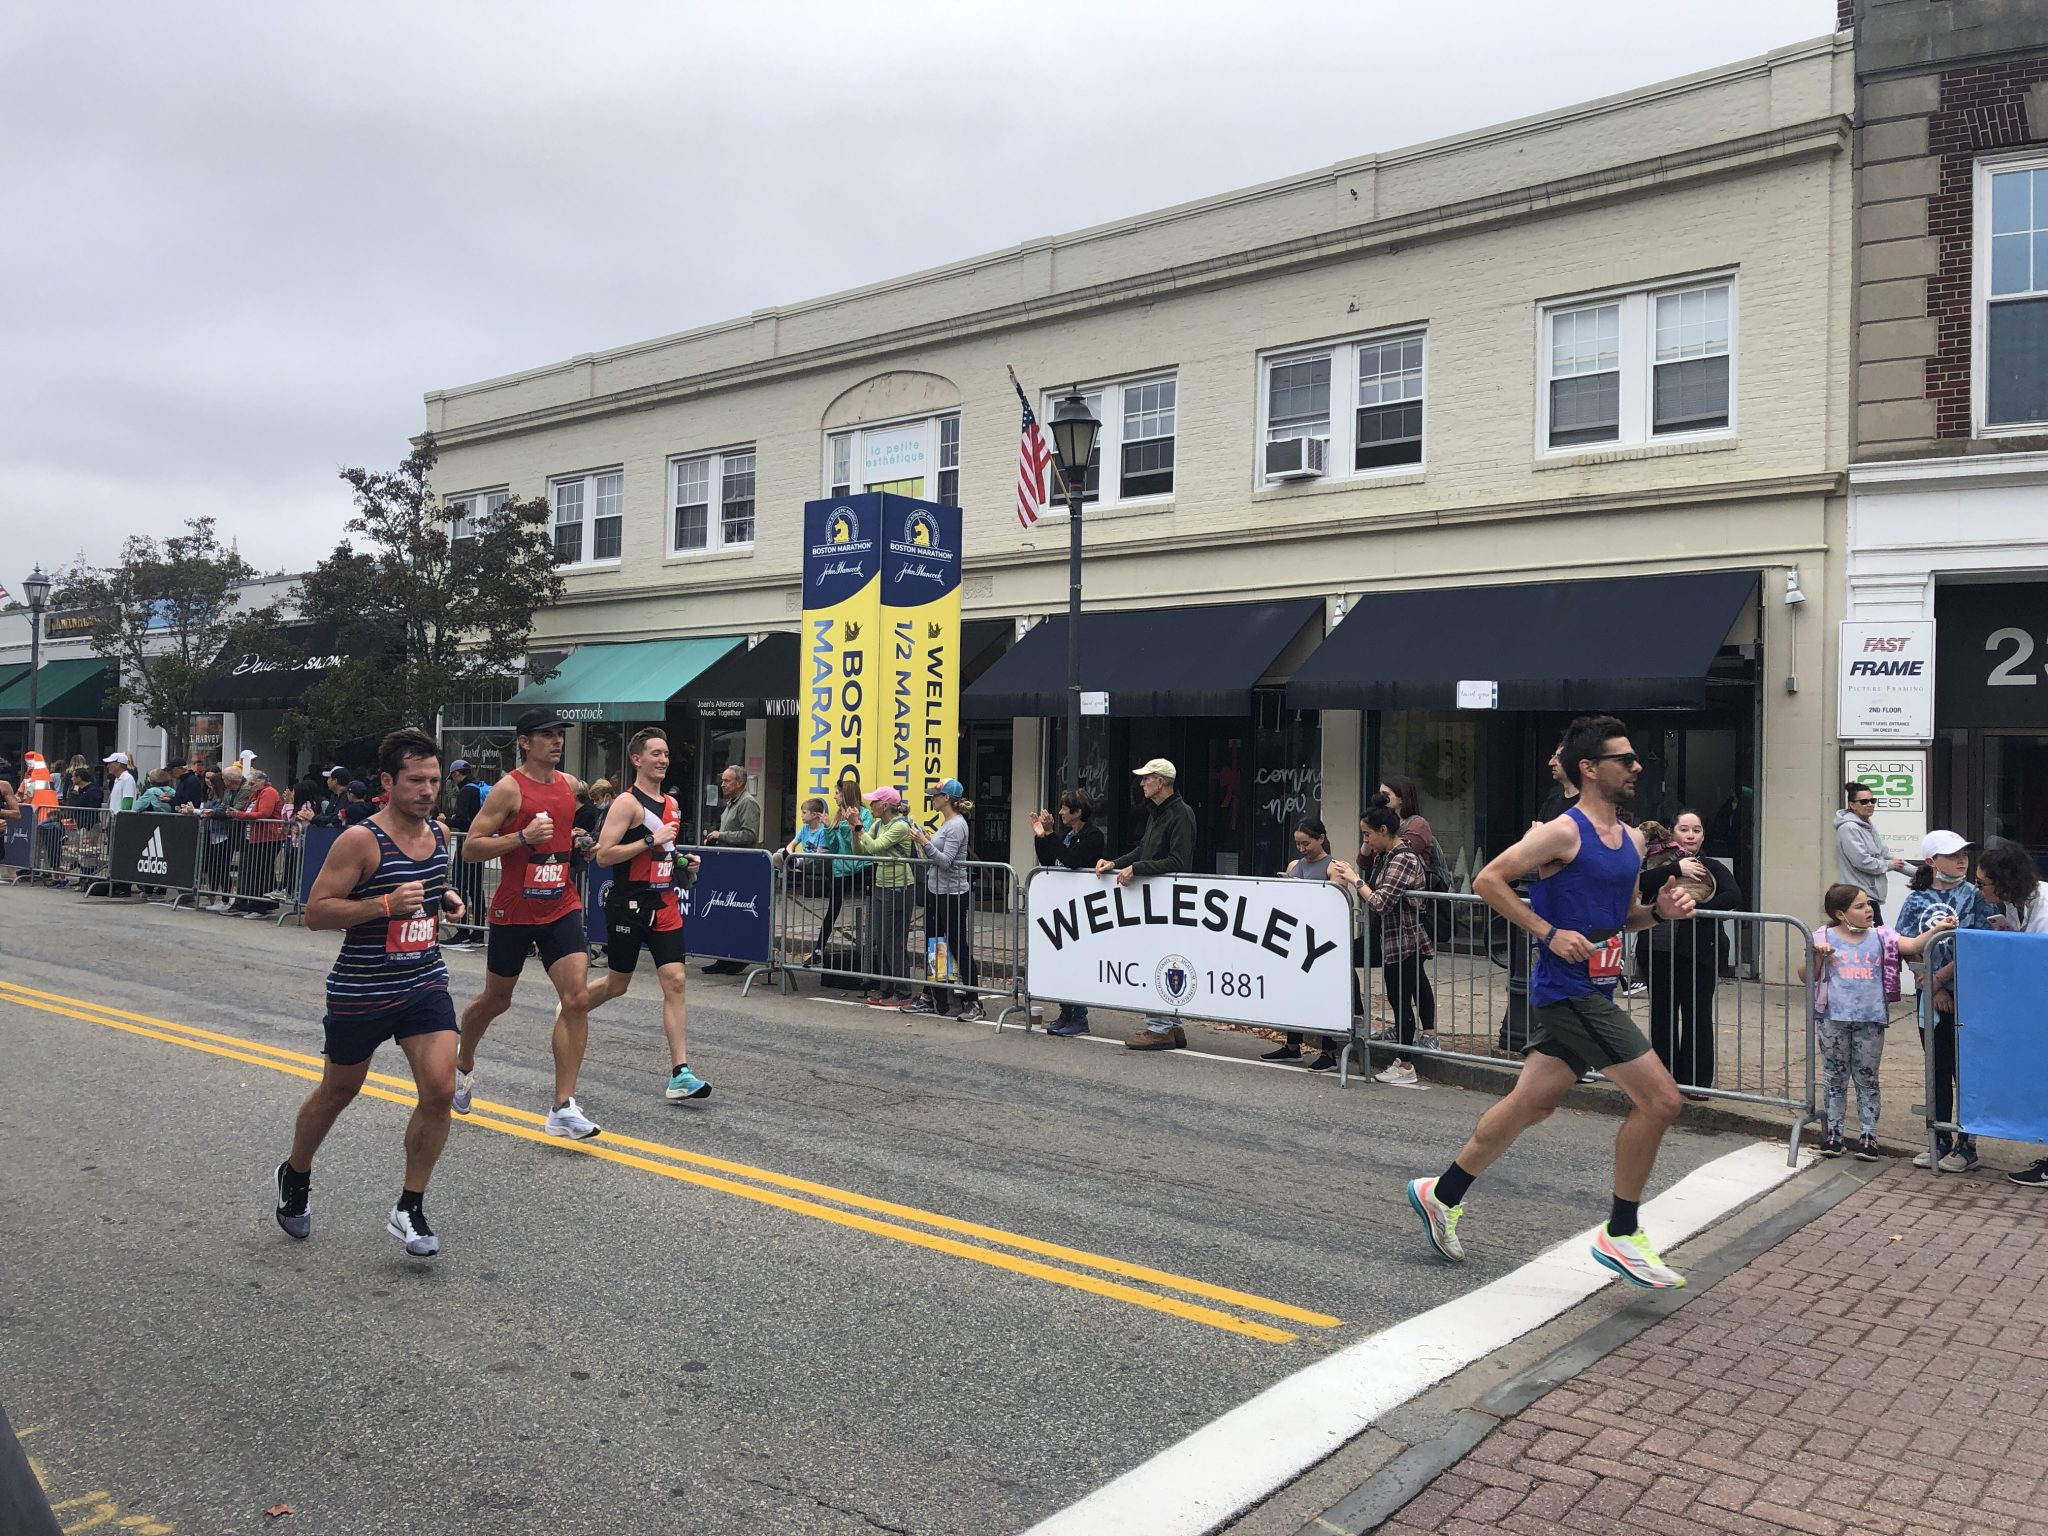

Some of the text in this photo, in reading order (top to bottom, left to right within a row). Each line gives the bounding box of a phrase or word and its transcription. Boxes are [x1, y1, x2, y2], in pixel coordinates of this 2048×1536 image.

[871, 441, 919, 456] la petite
[865, 452, 925, 468] esthétique
[812, 547, 837, 555] BOSTON
[890, 542, 917, 554] BOSTON
[835, 560, 865, 578] Hancock
[914, 563, 945, 587] Hancock
[894, 619, 915, 660] 1/2
[1863, 637, 1911, 652] FAST
[1850, 660, 1924, 676] FRAME
[556, 703, 604, 720] FOOTstock
[715, 700, 745, 708] Alterations
[718, 708, 742, 717] Together
[1856, 763, 1914, 773] SALON
[1254, 764, 1323, 800] coming
[1857, 774, 1914, 796] 23
[1876, 797, 1915, 808] EST
[137, 858, 168, 875] adidas
[534, 864, 564, 882] 2662
[701, 889, 725, 918] John
[722, 890, 759, 918] Hancock
[400, 918, 435, 943] 1686
[1036, 883, 1338, 974] WELLESLEY
[1099, 959, 1147, 988] INC.
[1206, 970, 1265, 1000] 1881
